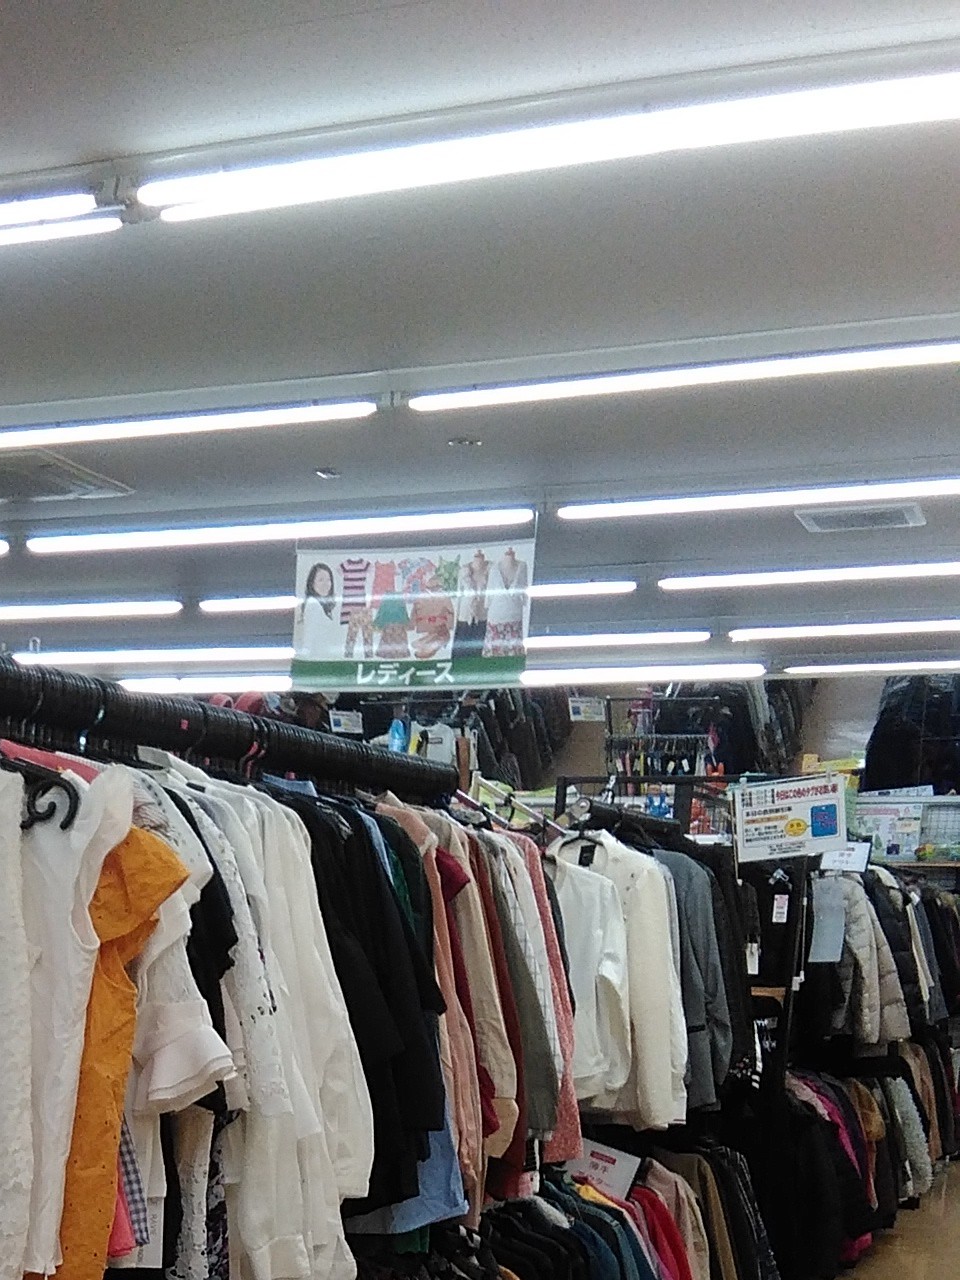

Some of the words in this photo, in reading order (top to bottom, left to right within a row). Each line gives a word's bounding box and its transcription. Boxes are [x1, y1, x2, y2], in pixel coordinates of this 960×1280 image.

[357, 662, 455, 685] レディース
